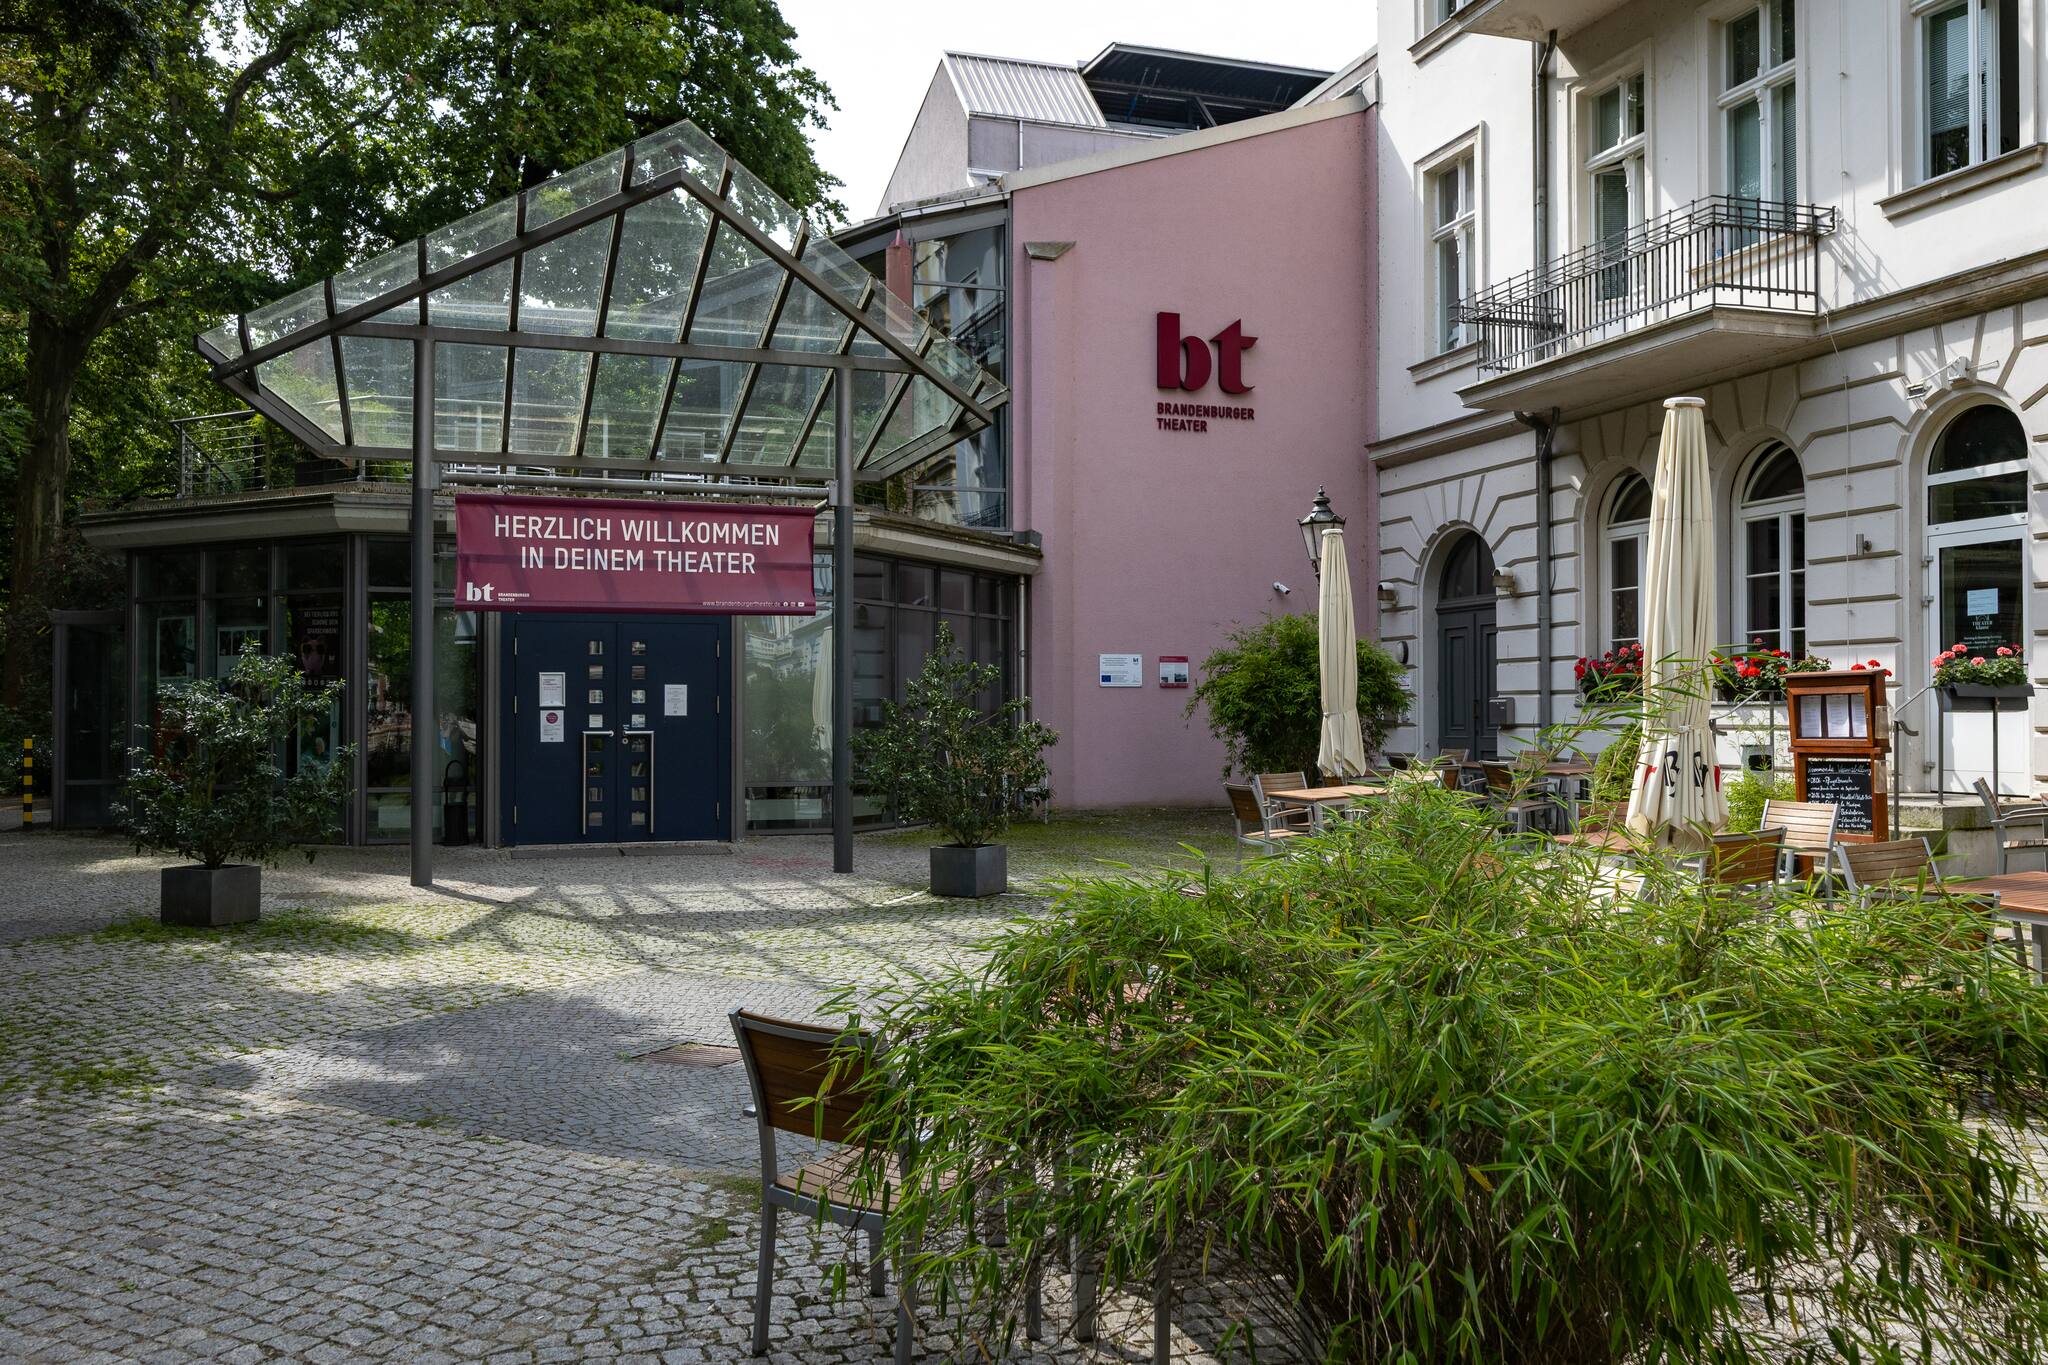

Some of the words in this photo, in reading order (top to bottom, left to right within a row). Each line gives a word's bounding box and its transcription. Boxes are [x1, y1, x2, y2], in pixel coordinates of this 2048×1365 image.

[1157, 312, 1258, 394] bt
[1157, 402, 1255, 420] BRANDENBURGER
[1157, 417, 1208, 432] THEATER
[495, 515, 611, 541] HERZLICH
[622, 519, 779, 546] WILLKOMMEN
[521, 546, 544, 569] IN
[554, 547, 644, 572] DEINEM
[653, 550, 755, 575] THEATER
[466, 582, 495, 602] bt
[702, 600, 781, 608] www.brandenburgertheater.de
